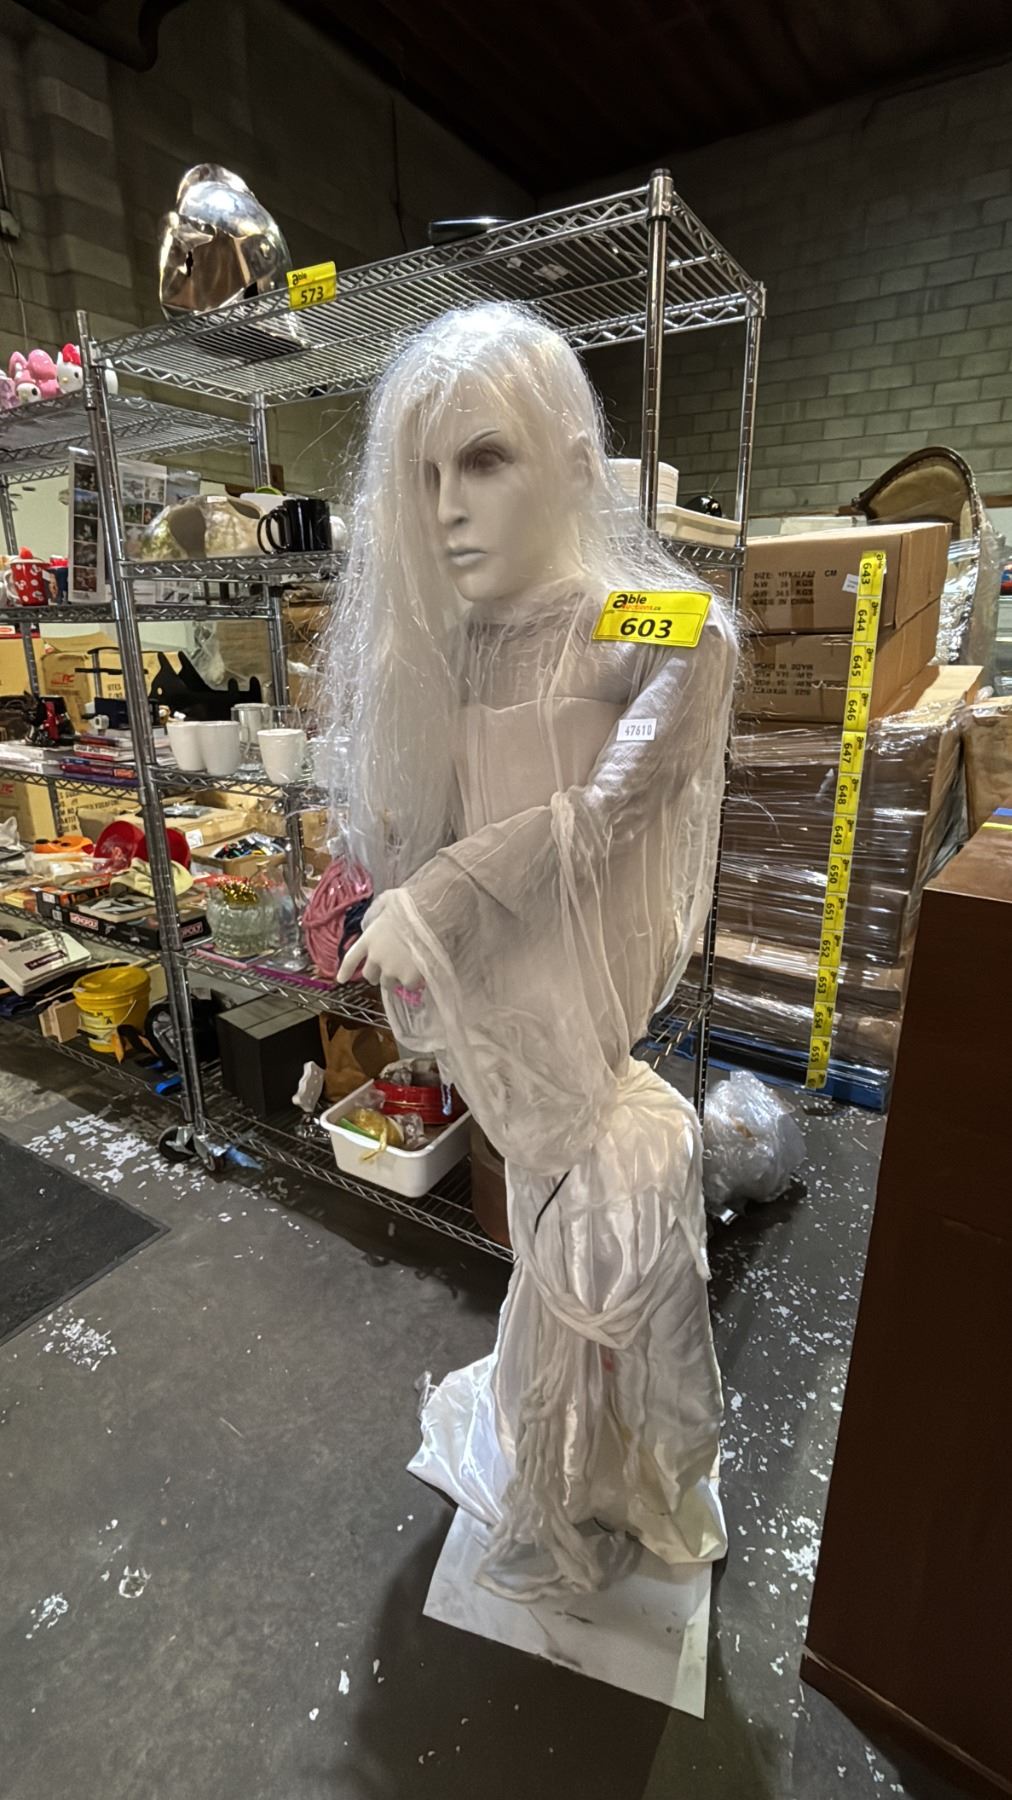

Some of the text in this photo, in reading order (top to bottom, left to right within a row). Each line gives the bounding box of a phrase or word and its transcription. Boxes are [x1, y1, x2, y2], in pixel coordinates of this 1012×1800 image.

[301, 286, 323, 304] 573
[861, 562, 872, 585] 643
[612, 593, 647, 609] able
[620, 617, 673, 639] 603
[856, 609, 867, 632] 644
[851, 655, 862, 677] 645
[846, 699, 857, 721] 646
[624, 724, 653, 737] 47610
[842, 742, 852, 764] 647
[837, 784, 848, 805] 648
[833, 825, 844, 845] 649
[829, 864, 839, 884] 650
[825, 902, 835, 920] 651
[821, 939, 831, 958] 652
